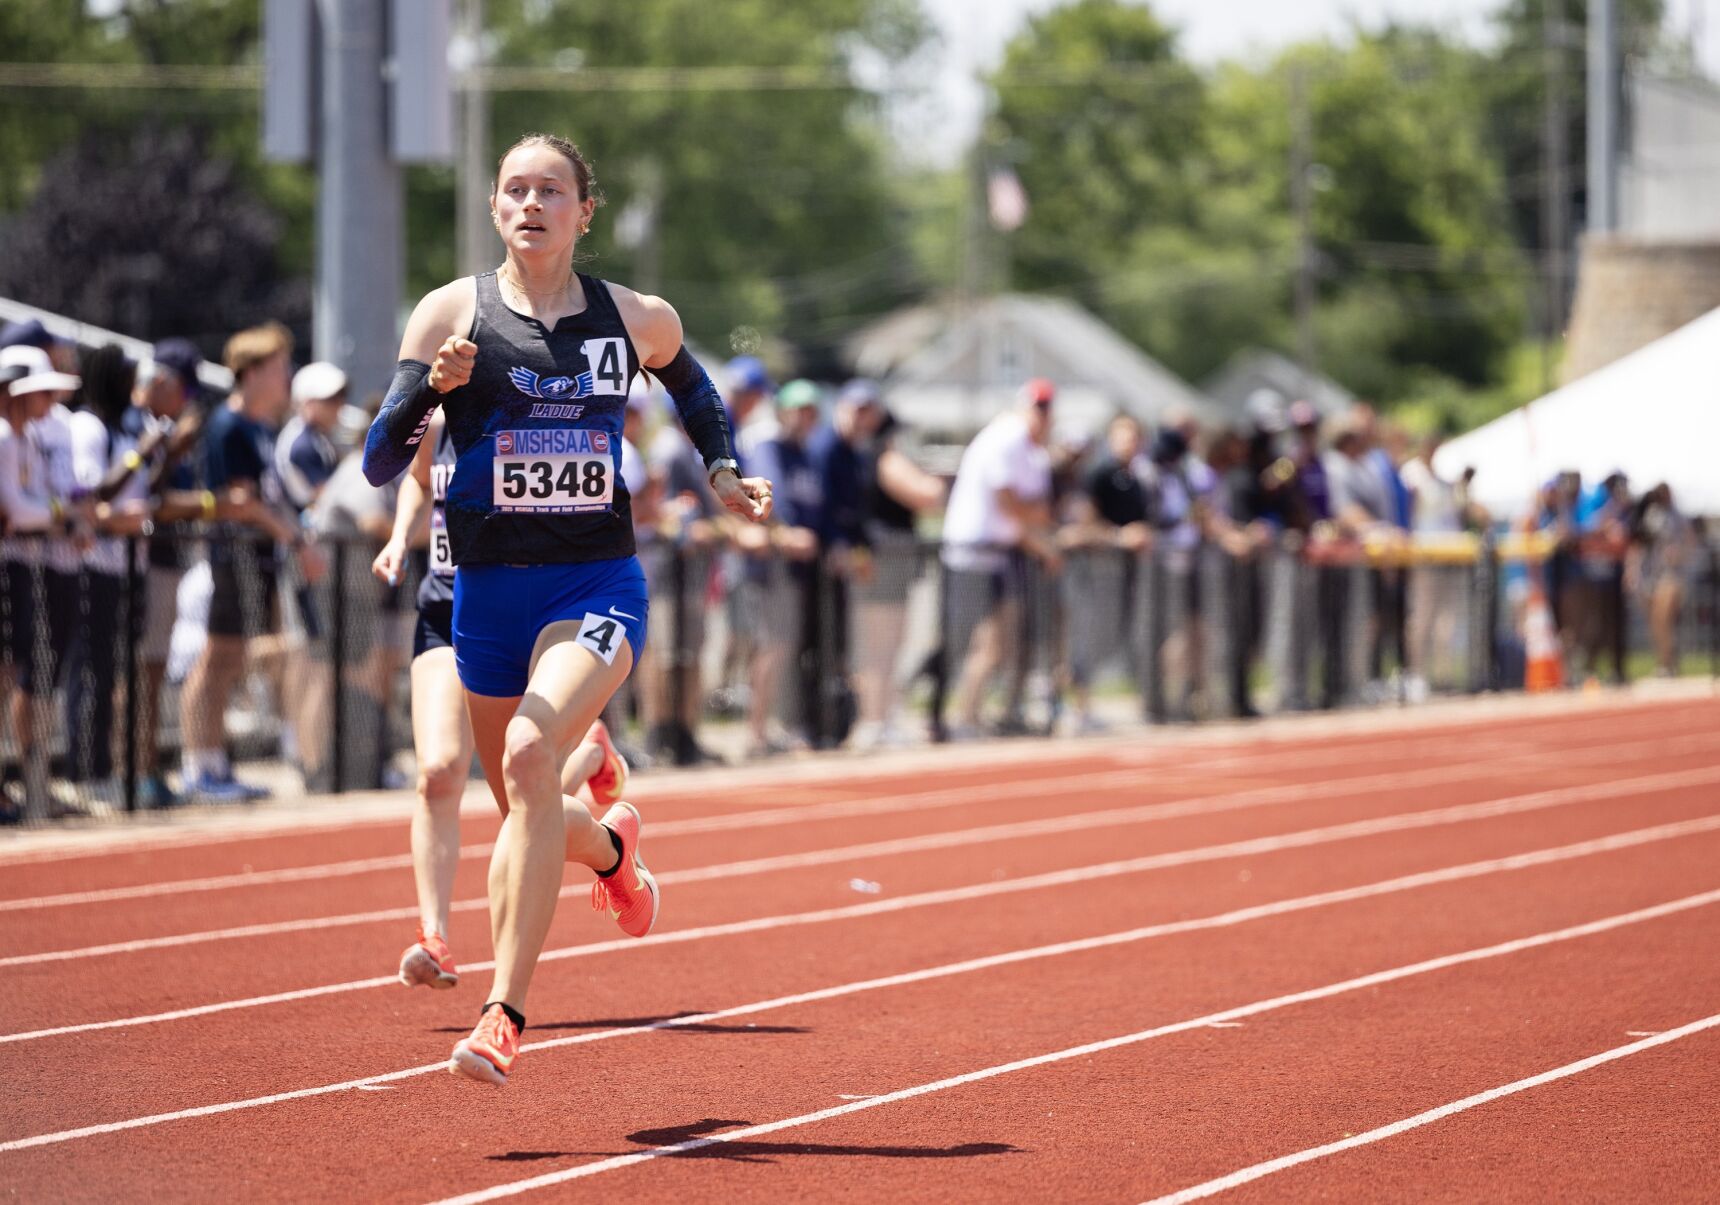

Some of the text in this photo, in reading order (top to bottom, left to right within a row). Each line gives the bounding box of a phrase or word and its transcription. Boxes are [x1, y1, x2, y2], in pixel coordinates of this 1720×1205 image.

[597, 341, 624, 391] 4
[528, 403, 585, 420] LADUE
[515, 430, 592, 454] MSHSAA
[502, 460, 606, 499] 5348
[583, 619, 618, 655] 4
